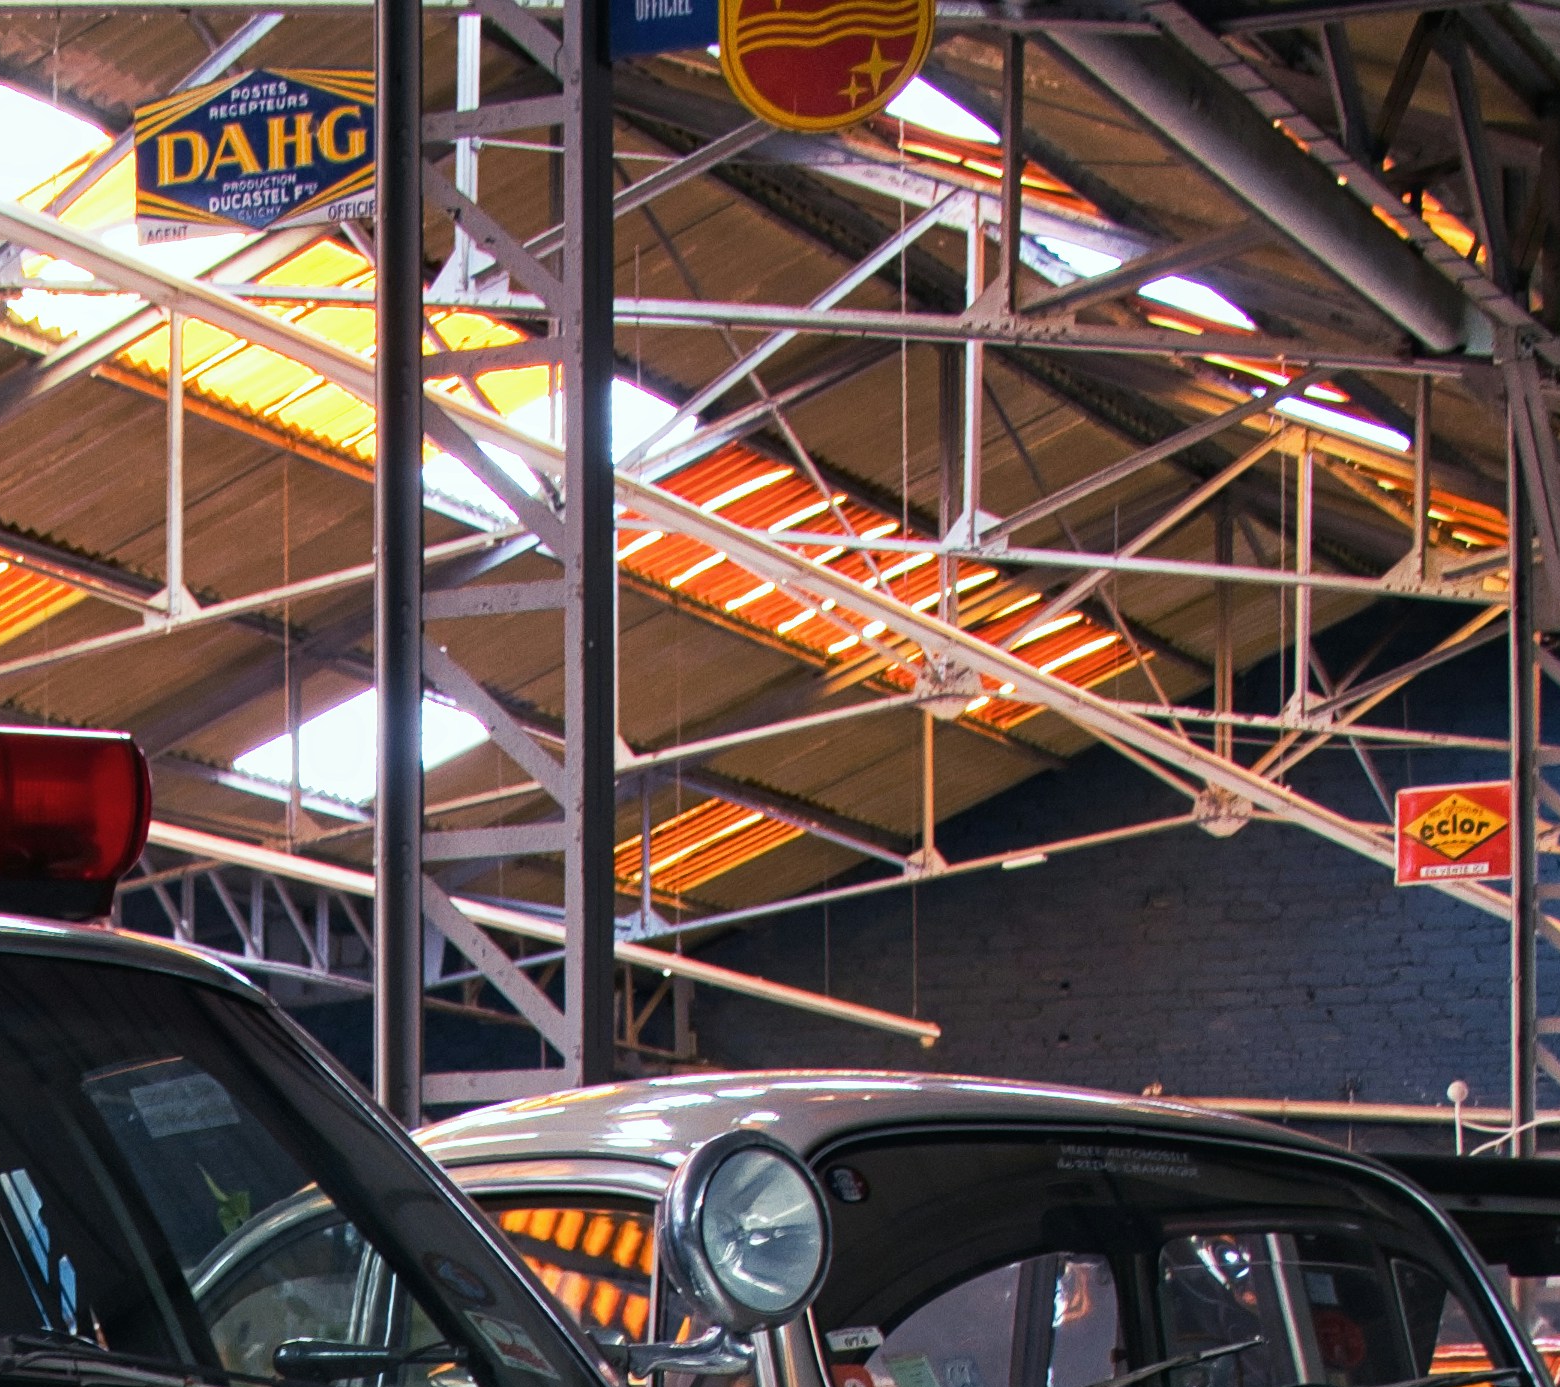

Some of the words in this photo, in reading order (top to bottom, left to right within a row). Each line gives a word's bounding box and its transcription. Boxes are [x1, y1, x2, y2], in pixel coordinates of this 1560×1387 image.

[230, 80, 288, 101] POSTES
[208, 93, 310, 121] RECEPTEURS
[156, 105, 368, 187] DAHG
[222, 173, 297, 193] PRODUCTION
[208, 190, 289, 213] DUCASTEL
[327, 200, 376, 220] OFFICIE
[146, 226, 188, 242] AGENT
